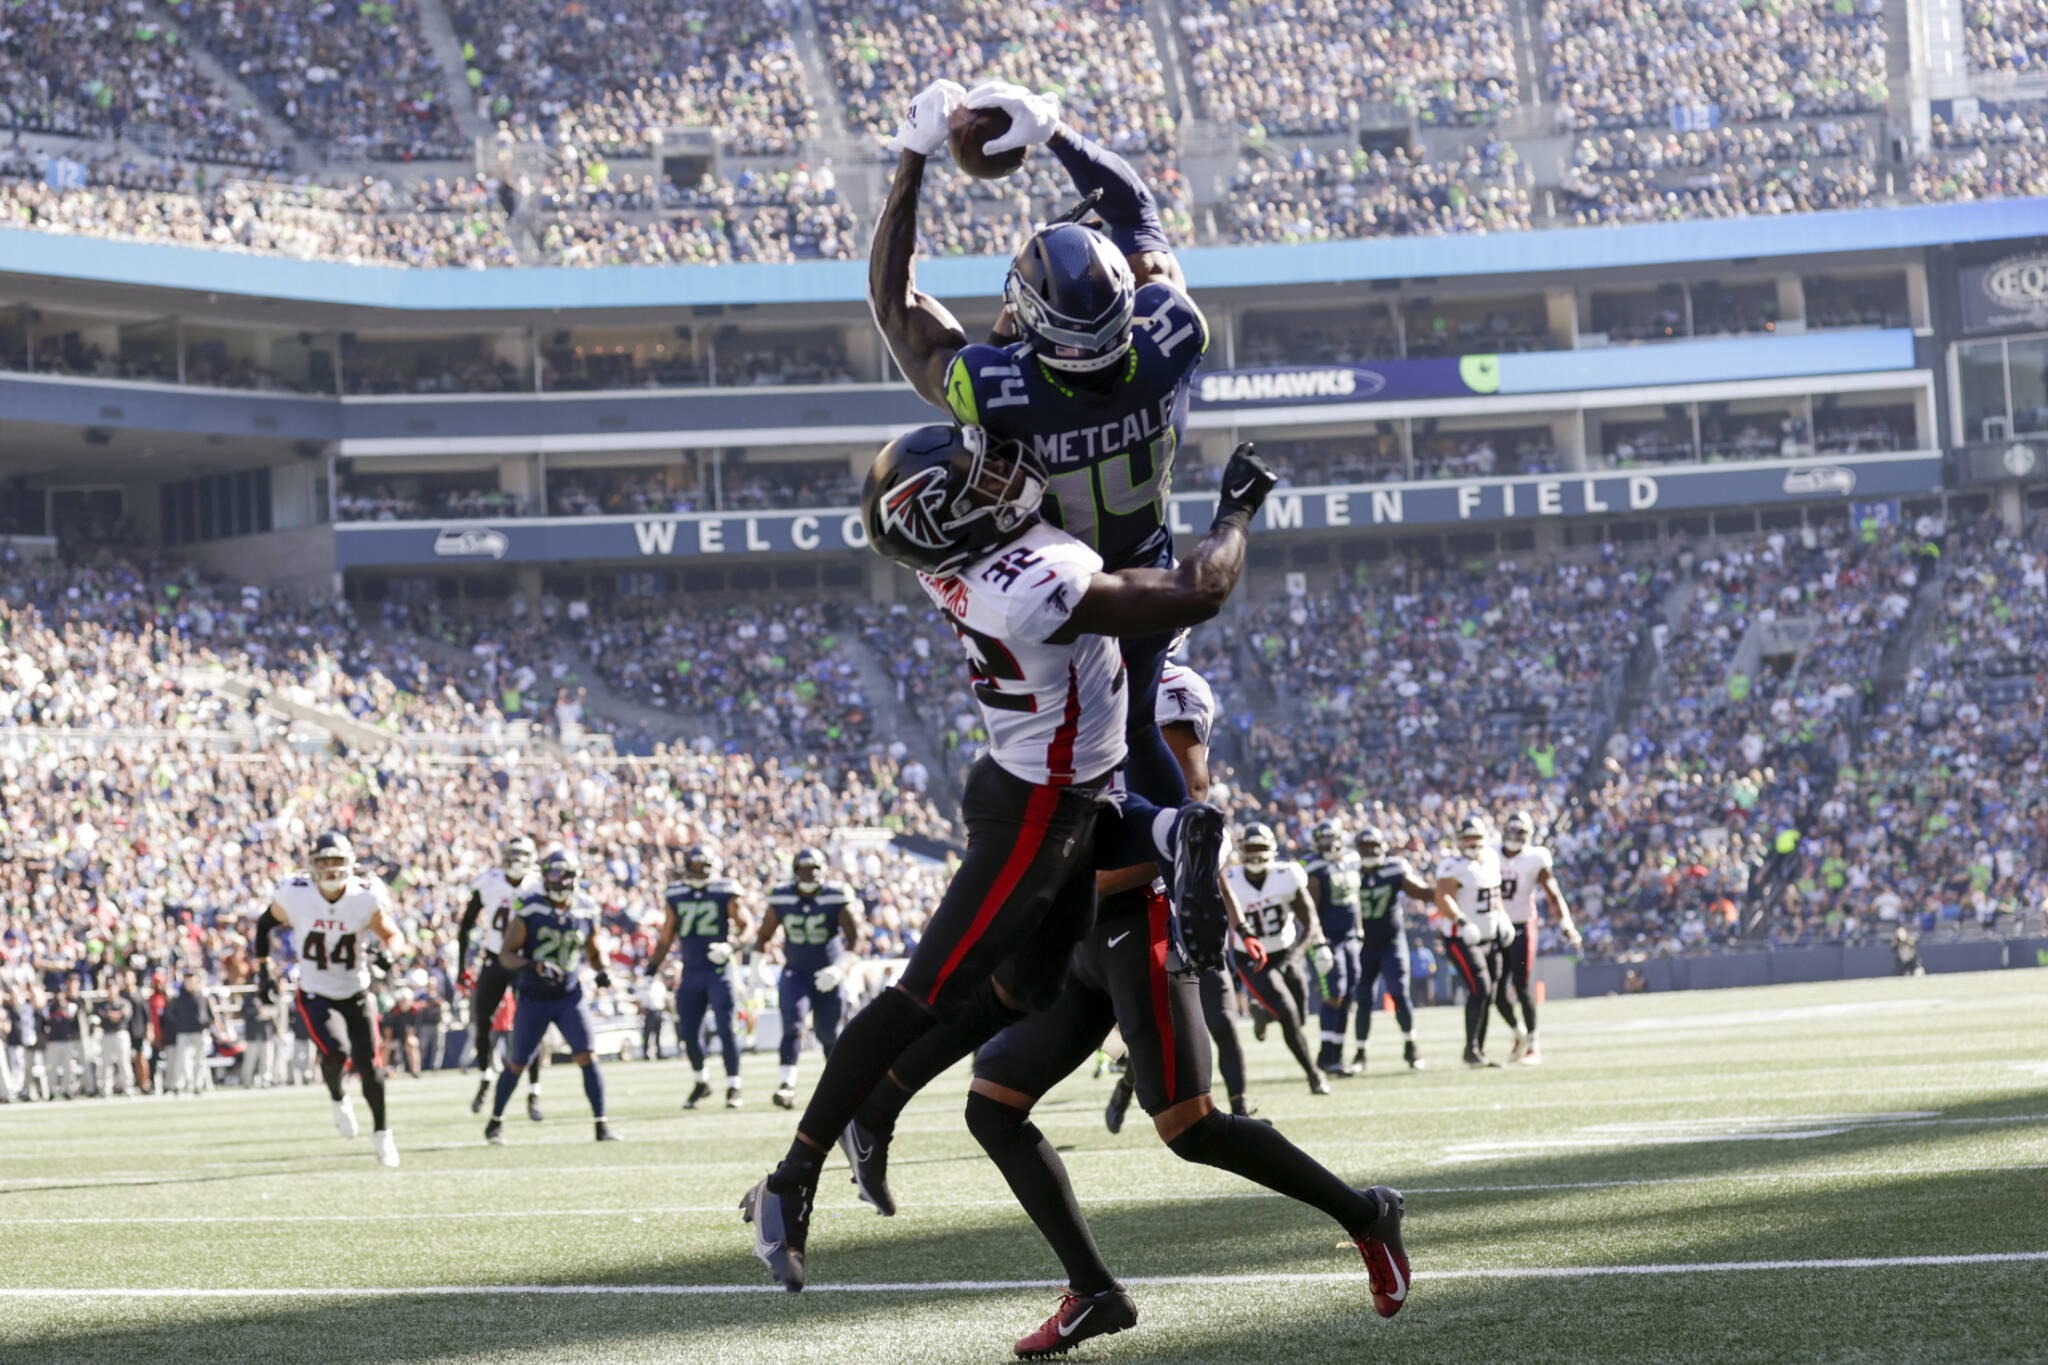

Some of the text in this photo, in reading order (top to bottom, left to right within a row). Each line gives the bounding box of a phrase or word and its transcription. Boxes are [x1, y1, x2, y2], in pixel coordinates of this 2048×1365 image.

[1142, 298, 1195, 358] 14
[979, 363, 1030, 409] 14
[1201, 369, 1356, 401] SEAHAWKS
[634, 477, 1658, 556] WELCO LMEN FIELD
[981, 546, 1046, 593] 32
[313, 919, 348, 931] ATL
[676, 901, 719, 937] 72
[303, 931, 357, 971] 44
